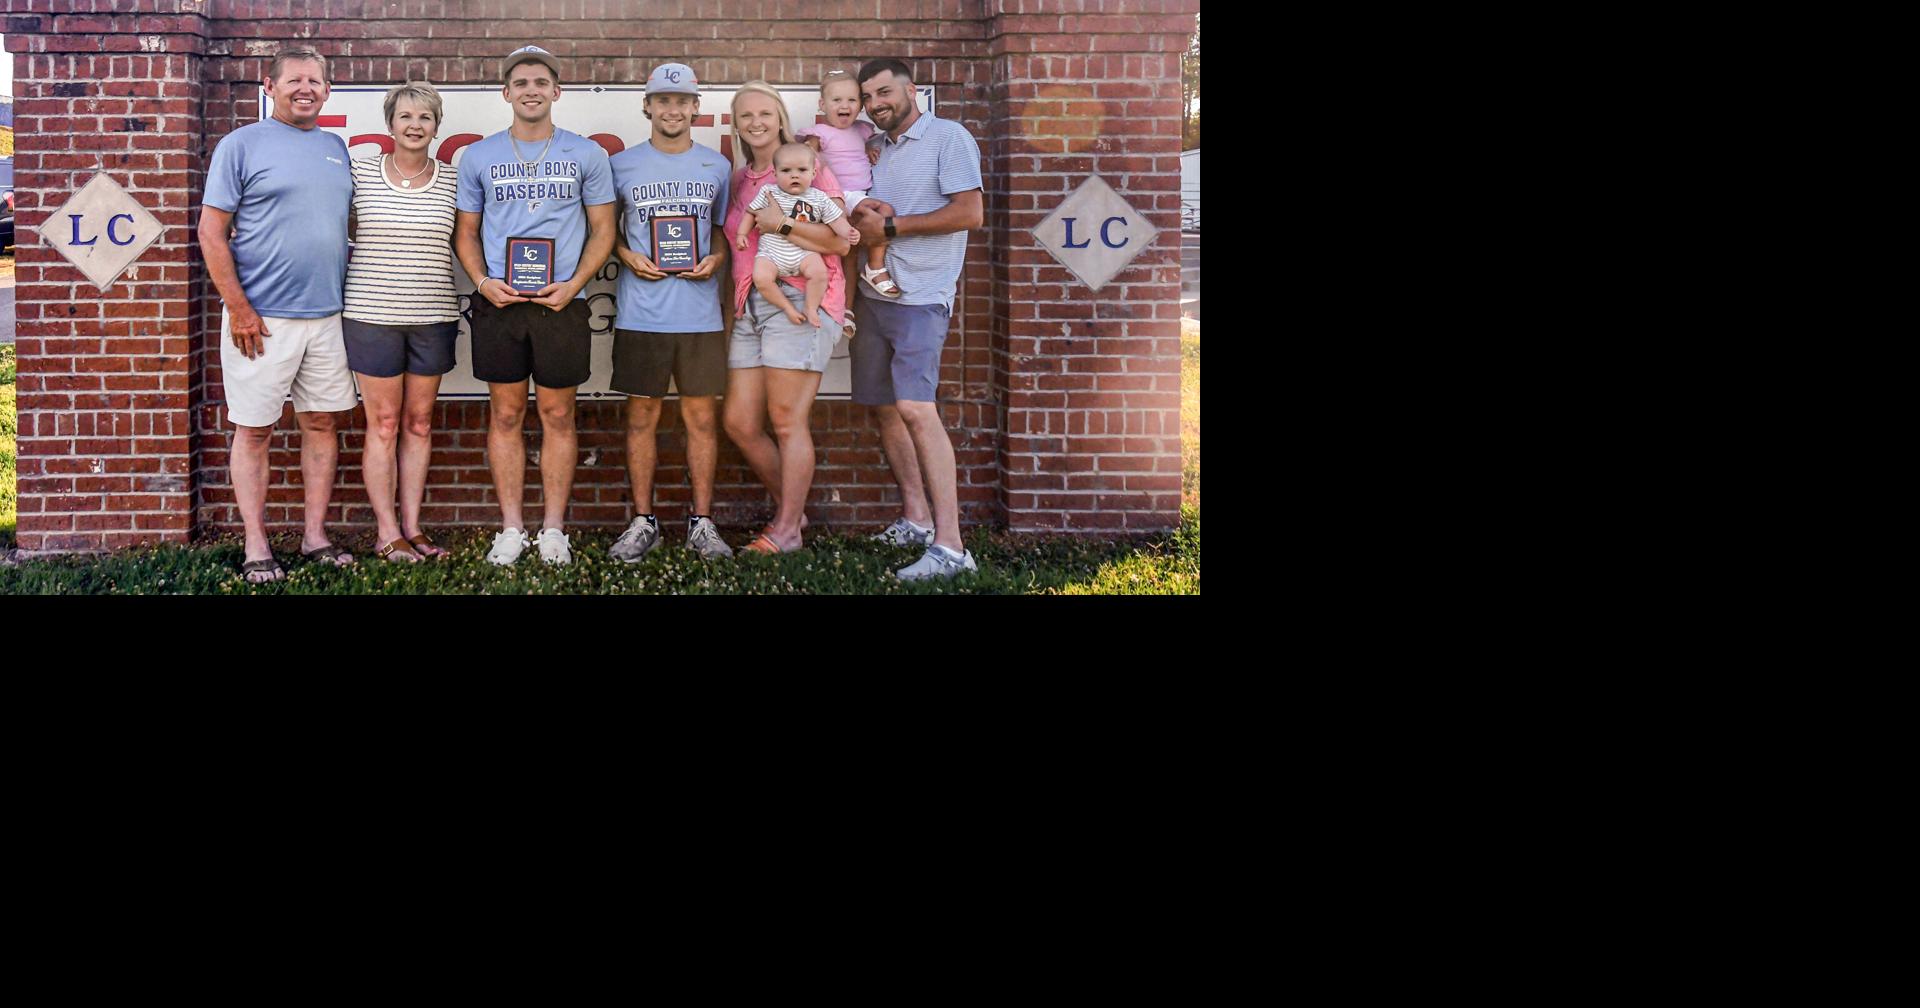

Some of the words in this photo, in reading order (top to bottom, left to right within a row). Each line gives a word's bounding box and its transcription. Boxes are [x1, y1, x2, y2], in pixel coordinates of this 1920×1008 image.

[664, 69, 680, 84] LC
[490, 162, 539, 179] COUNTY
[544, 161, 577, 177] BOYS
[494, 183, 573, 202] BASEBALL
[632, 182, 680, 202] COUNTY
[686, 181, 715, 199] BOYS
[667, 223, 682, 238] LC
[523, 246, 538, 261] LC
